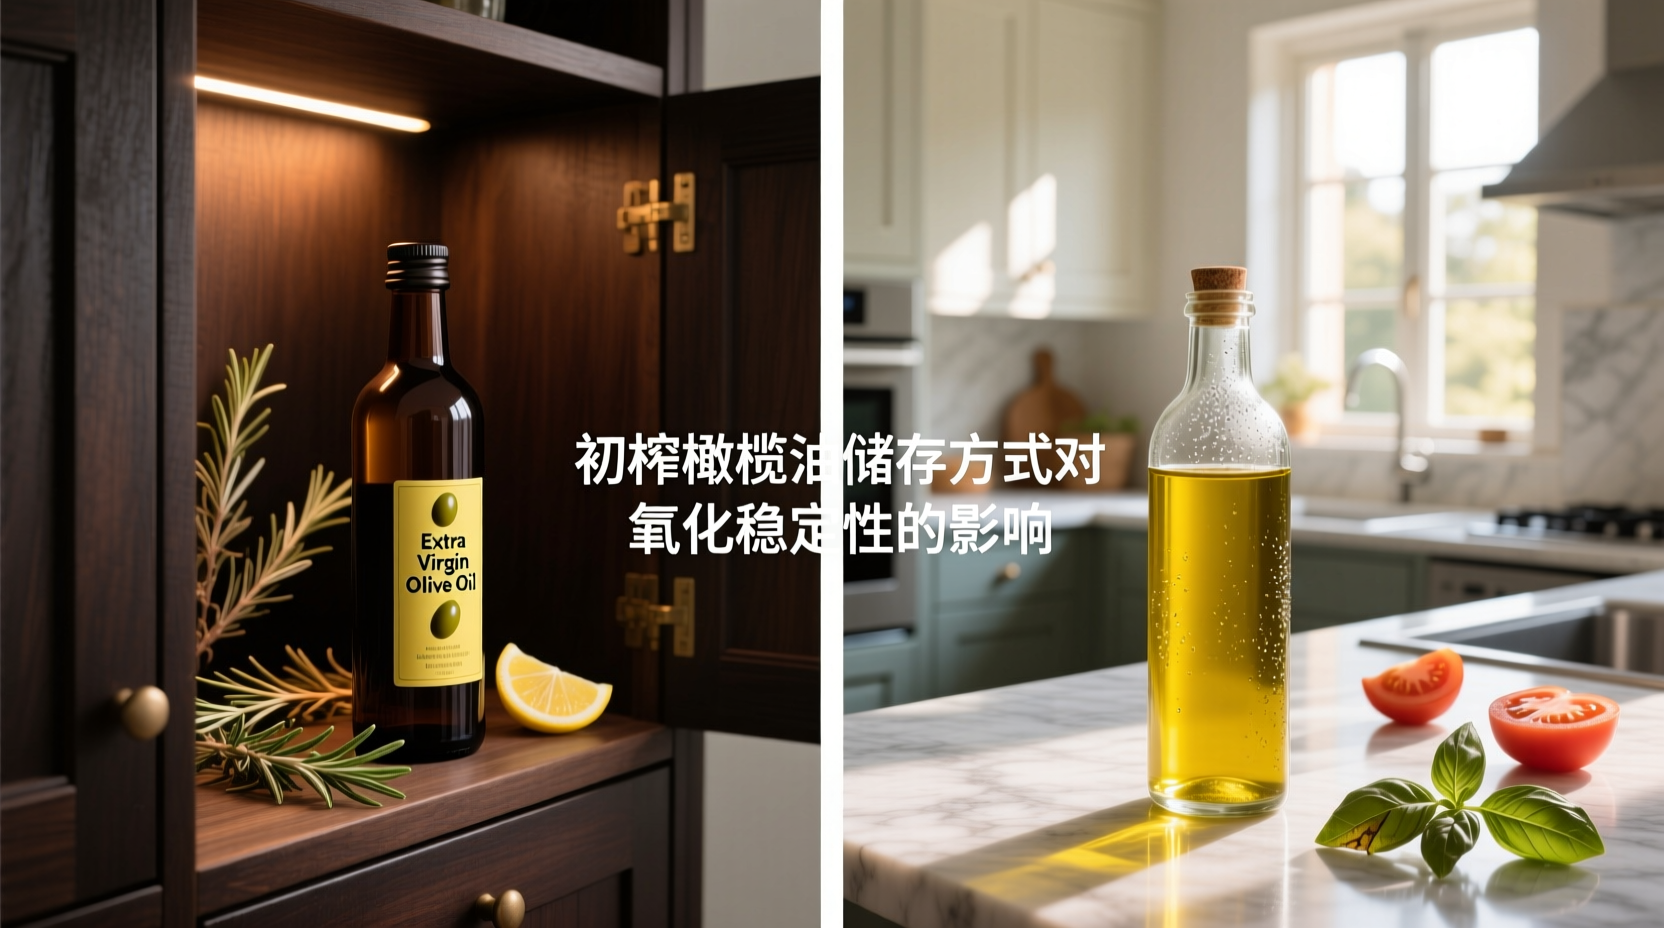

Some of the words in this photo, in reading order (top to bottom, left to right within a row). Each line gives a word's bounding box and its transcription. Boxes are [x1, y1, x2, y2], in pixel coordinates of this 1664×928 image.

[421, 533, 466, 550] Extra
[417, 553, 469, 575] Virgin
[406, 576, 452, 593] Olive
[456, 573, 476, 591] Oil
